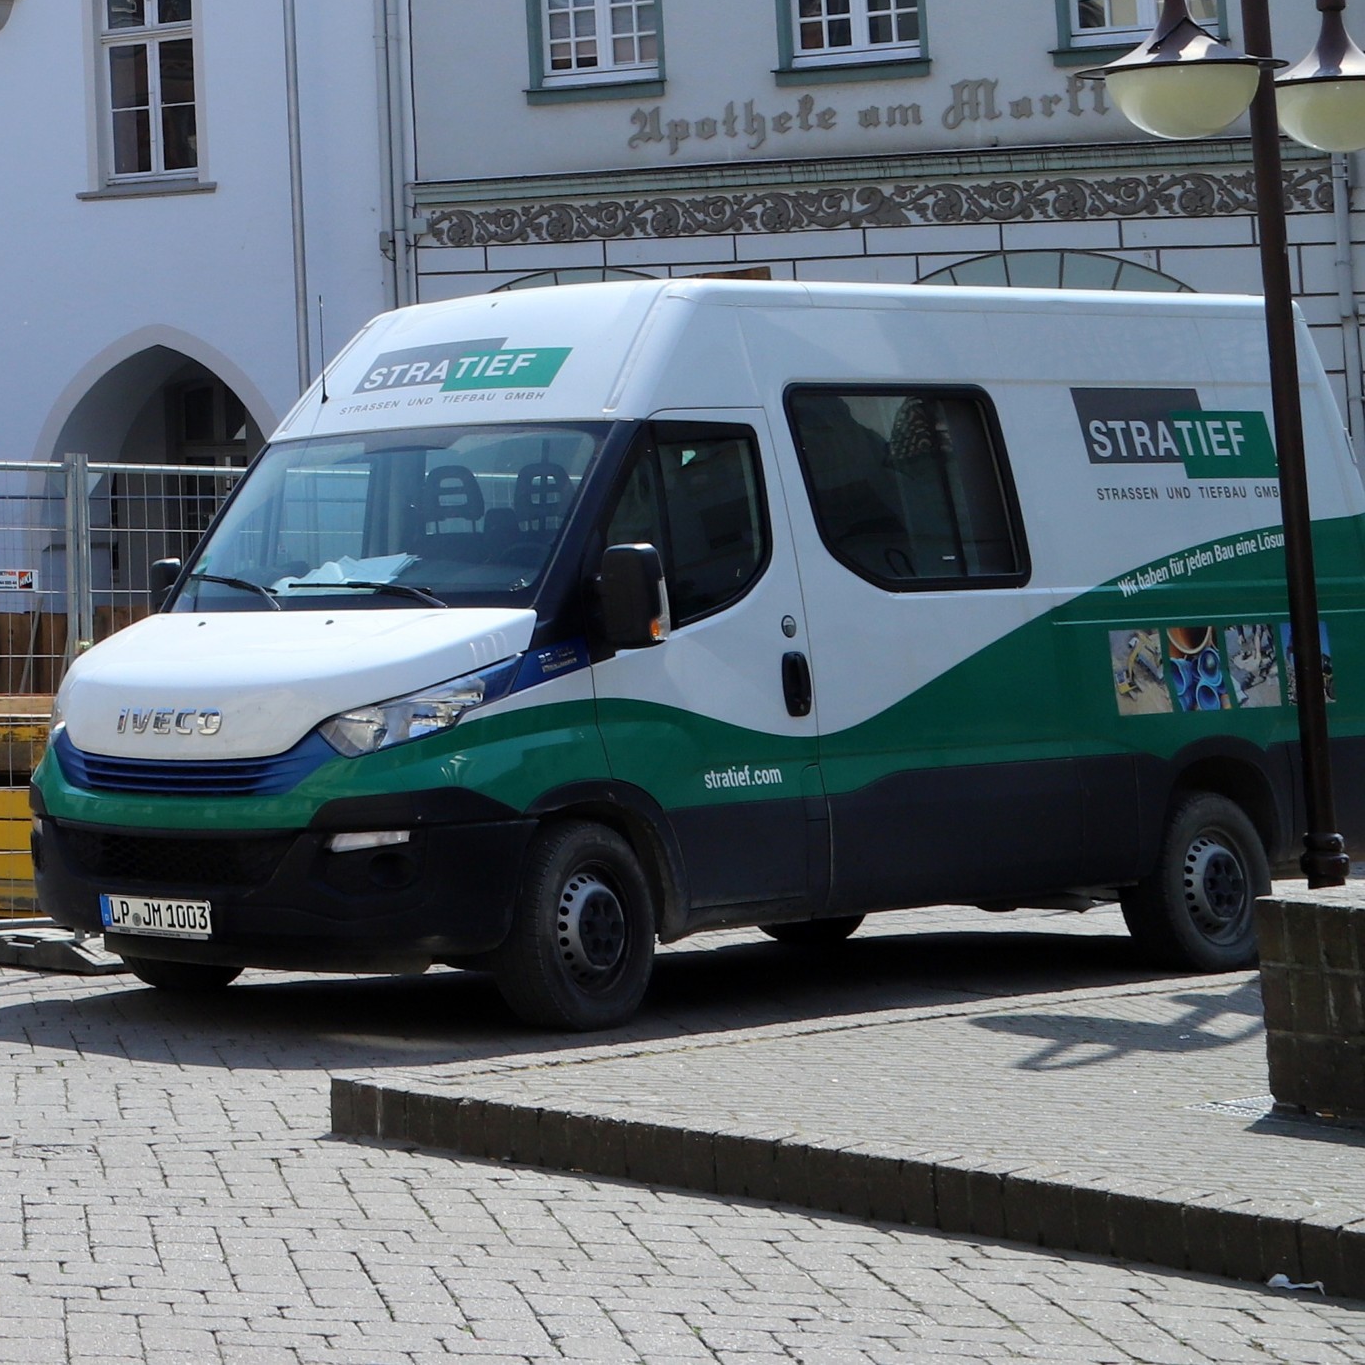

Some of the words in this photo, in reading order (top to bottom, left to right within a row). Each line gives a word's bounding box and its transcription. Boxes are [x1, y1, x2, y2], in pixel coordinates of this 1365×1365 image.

[627, 93, 837, 154] Apotheke
[857, 101, 923, 129] am
[941, 77, 1111, 131] Markt
[364, 353, 537, 389] STRATIEF
[339, 400, 399, 416] STRASSEN
[407, 397, 434, 407] UND
[442, 393, 496, 404] TIEFBAU
[504, 391, 545, 401] GMBH
[1089, 420, 1246, 458] STRATIEF
[1097, 488, 1159, 501] STRASSEN
[1166, 487, 1191, 499] UND
[1198, 487, 1247, 499] TIEFBAU
[1254, 486, 1280, 499] GMB
[1117, 578, 1137, 598] Wir
[1136, 566, 1169, 590] haben
[1169, 557, 1185, 578] für
[1184, 548, 1214, 576] jeden
[1214, 543, 1235, 563] Bau
[1235, 537, 1258, 556] eine
[117, 707, 224, 736] IVECO
[704, 765, 783, 790] stratief.com
[110, 899, 130, 925] LP
[143, 902, 163, 928] JM
[166, 904, 209, 930] 1003
